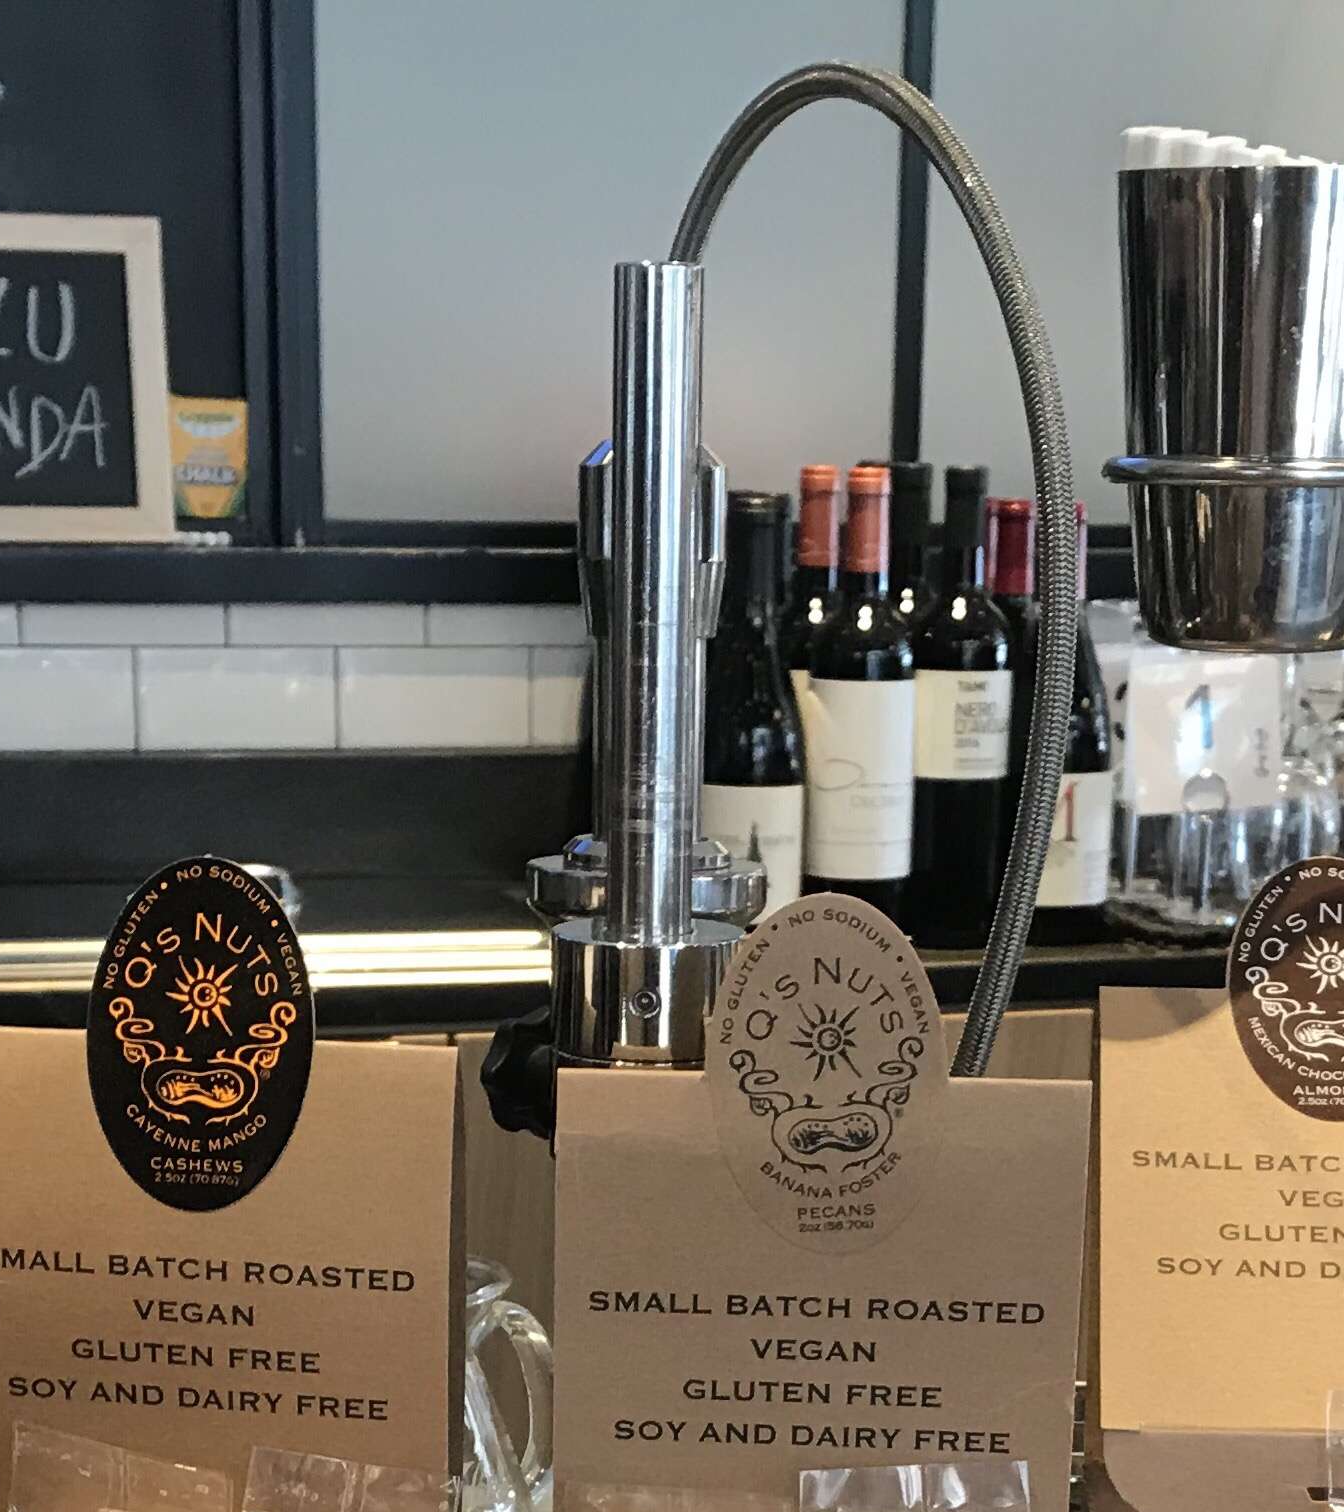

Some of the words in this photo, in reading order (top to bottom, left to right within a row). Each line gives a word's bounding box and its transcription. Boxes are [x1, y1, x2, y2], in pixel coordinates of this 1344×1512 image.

[1298, 866, 1323, 881] NO
[1244, 885, 1285, 938] GLUTEN
[102, 962, 120, 991] NO
[112, 887, 161, 960] GLUTEN
[176, 864, 203, 883] NO
[209, 865, 273, 916] SODIUM
[275, 931, 305, 997] VEGAN
[1260, 912, 1308, 962] Q'S
[124, 926, 182, 989] Q'S
[193, 911, 279, 998] NUTS
[1238, 940, 1251, 963] NO
[719, 1018, 734, 1045] NO
[727, 936, 771, 1014] GLUTEN
[788, 908, 816, 929] NO
[823, 907, 892, 954] SODIUM
[899, 970, 931, 1036] VEGAN
[746, 974, 800, 1041] Q'S
[813, 956, 905, 1034] NUTS
[1248, 1016, 1296, 1070] MEXICAN
[126, 1103, 201, 1154] CAYENNE
[207, 1113, 268, 1153] MANGO
[150, 1156, 245, 1174] CASHEWS
[759, 1160, 834, 1199] BANANA
[838, 1150, 903, 1198] FOSTER
[1131, 1149, 1243, 1171] SMALL
[797, 1203, 877, 1220] PECANS
[107, 1253, 229, 1282] BATCH
[243, 1261, 416, 1292] ROASTED
[1156, 1256, 1223, 1276] SOY
[1235, 1258, 1307, 1279] AND
[132, 1298, 255, 1327] VEGAN
[588, 1290, 713, 1315] SMALL
[725, 1294, 852, 1320] BATCH
[866, 1297, 1046, 1326] ROASTED
[71, 1338, 214, 1367] GLUTEN
[228, 1348, 322, 1374] FREE
[749, 1337, 877, 1363] VEGAN
[7, 1375, 79, 1399] SOY
[90, 1383, 164, 1407] AND
[177, 1387, 282, 1415] DAIRY
[296, 1394, 390, 1421] FREE
[682, 1378, 831, 1405] GLUTEN
[846, 1384, 943, 1409] FREE
[613, 1419, 688, 1442] SOY
[698, 1421, 777, 1446] AND
[790, 1424, 903, 1451] DAIRY
[913, 1429, 1012, 1455] FREE
